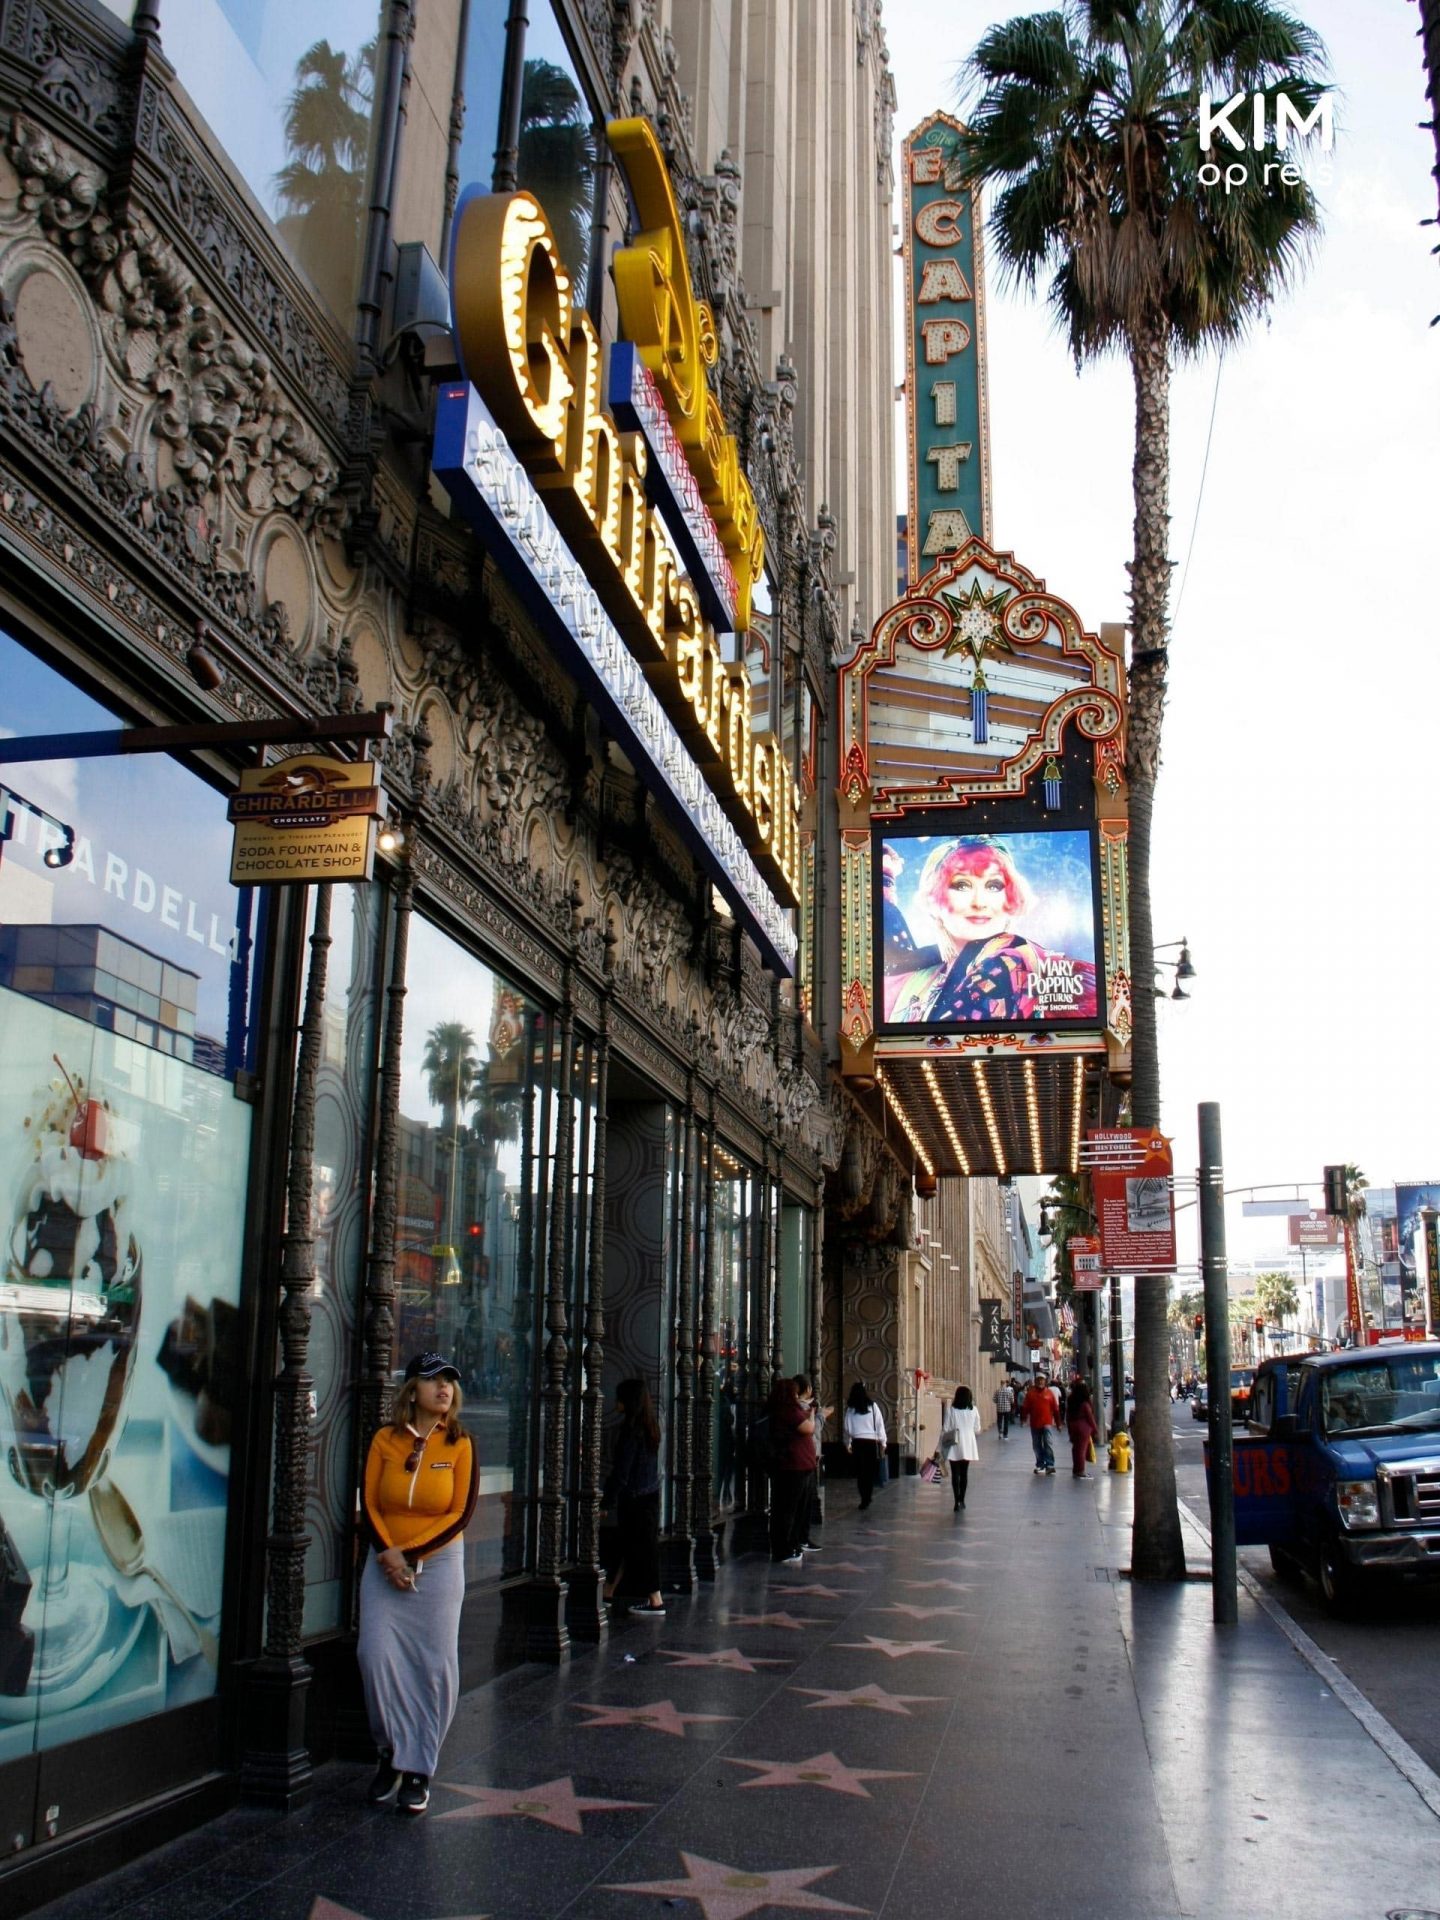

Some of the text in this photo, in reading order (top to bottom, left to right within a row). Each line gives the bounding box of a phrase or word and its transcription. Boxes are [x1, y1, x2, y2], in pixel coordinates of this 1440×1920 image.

[234, 793, 371, 811] GHIRARDELLI
[273, 816, 327, 824] CHOCOLATE
[239, 843, 361, 857] SODA FOUNTAIN &
[236, 856, 361, 871] CHOCOLATE SHOP
[1038, 958, 1074, 979] MARY
[1027, 973, 1084, 999] POPPINS
[1038, 993, 1073, 1004] RETURNS
[1094, 1132, 1132, 1140] HOLLYWOOD
[1095, 1143, 1132, 1151] HISTORIC
[1150, 1140, 1162, 1149] 42
[990, 1305, 999, 1344] ZARA
[1231, 1448, 1291, 1497] URS
